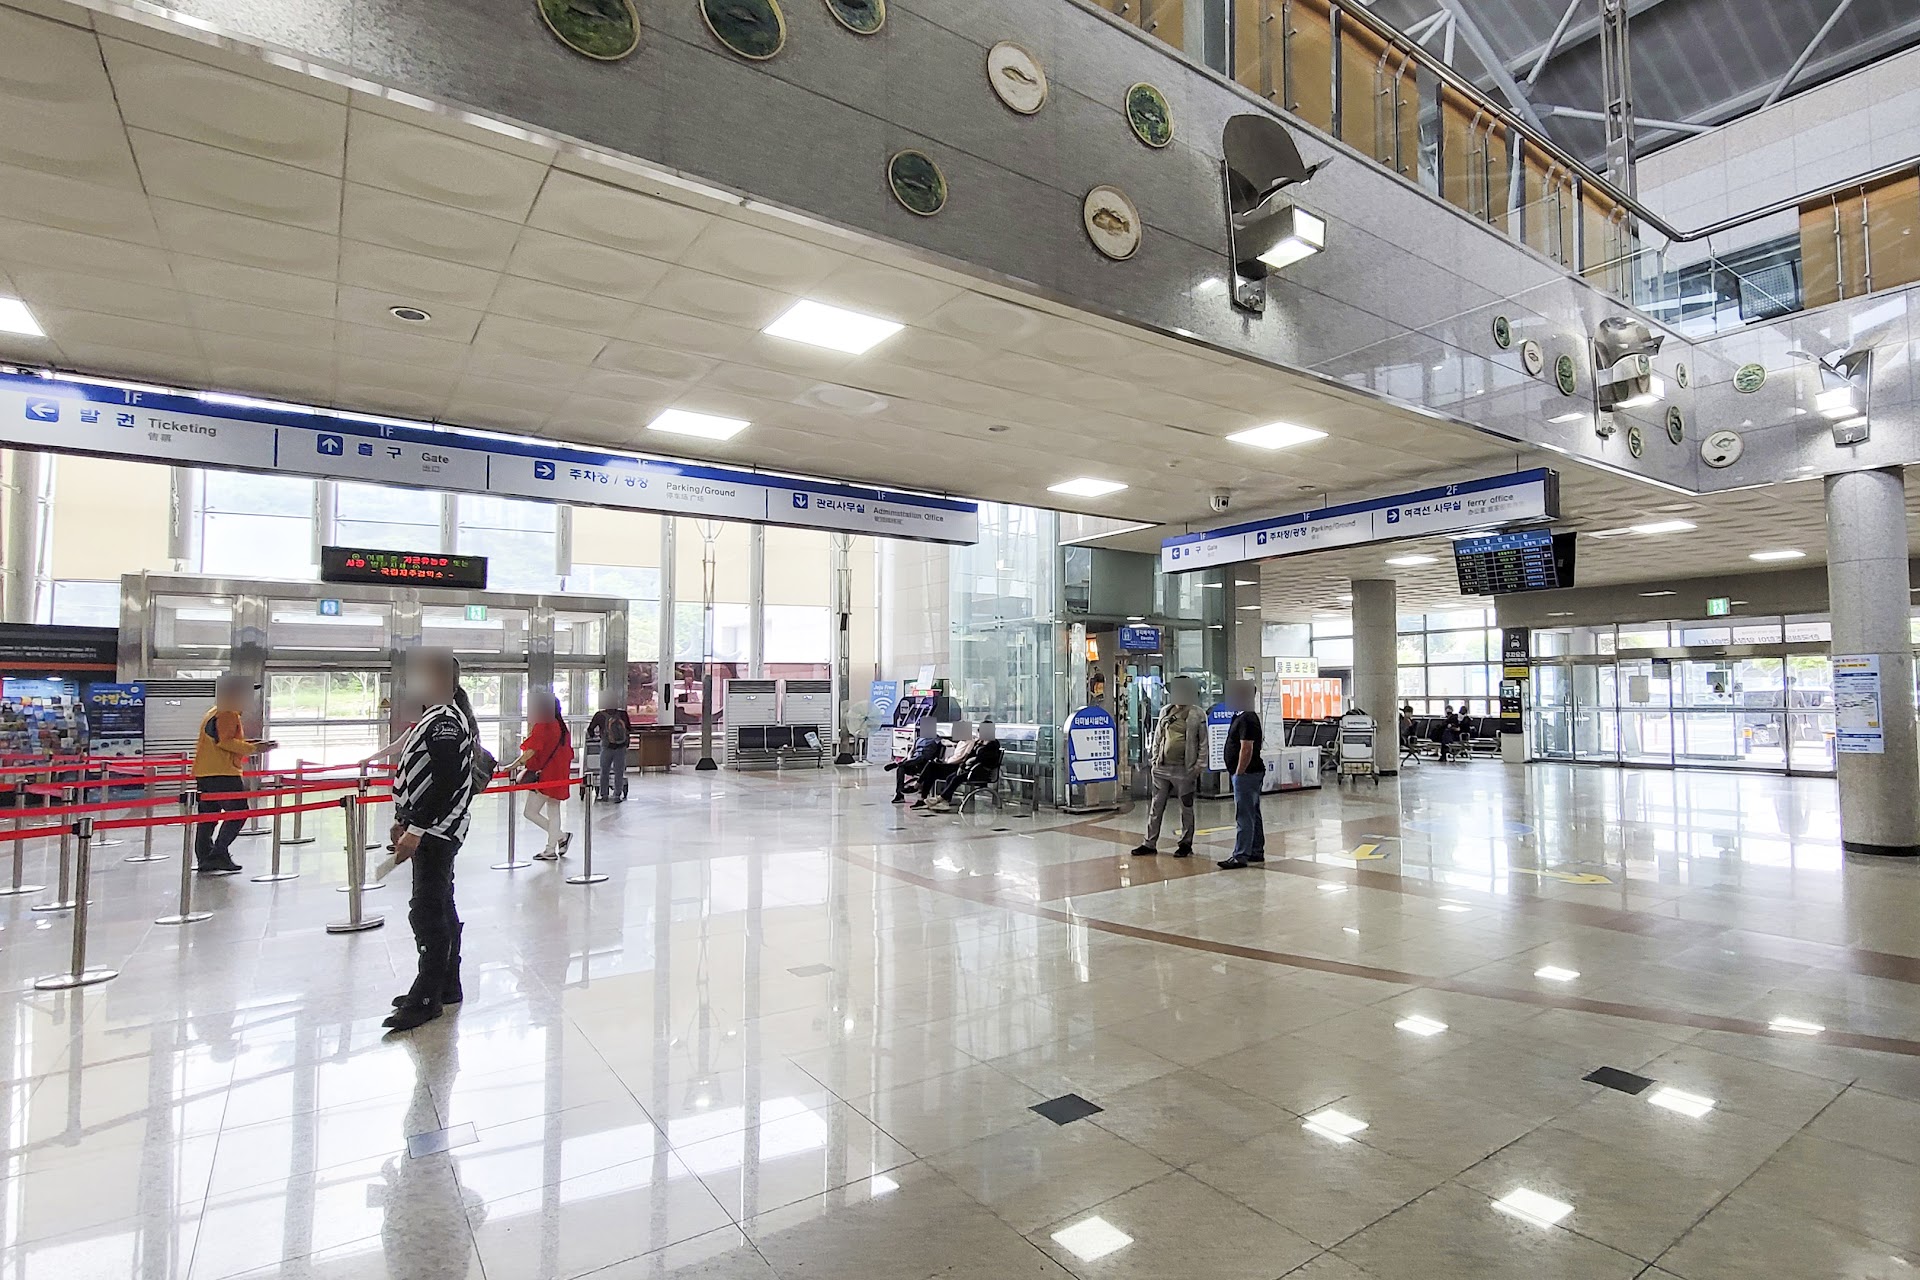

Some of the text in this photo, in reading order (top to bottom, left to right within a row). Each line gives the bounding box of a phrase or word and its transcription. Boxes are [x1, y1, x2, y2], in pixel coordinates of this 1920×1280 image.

[123, 390, 142, 404] 1F
[148, 417, 217, 437] Ticketing
[379, 425, 394, 437] 1F
[421, 452, 450, 463] Gate
[569, 468, 609, 484] 주차장
[666, 482, 736, 498] Parking/Ground
[1446, 485, 1459, 495] 2F
[816, 498, 865, 514] 관리사무실
[1434, 500, 1462, 513] 사무실
[1467, 498, 1487, 508] ferry
[1490, 493, 1514, 503] office
[1303, 513, 1311, 522] 1F
[1074, 715, 1109, 726] 터미널시설안내
